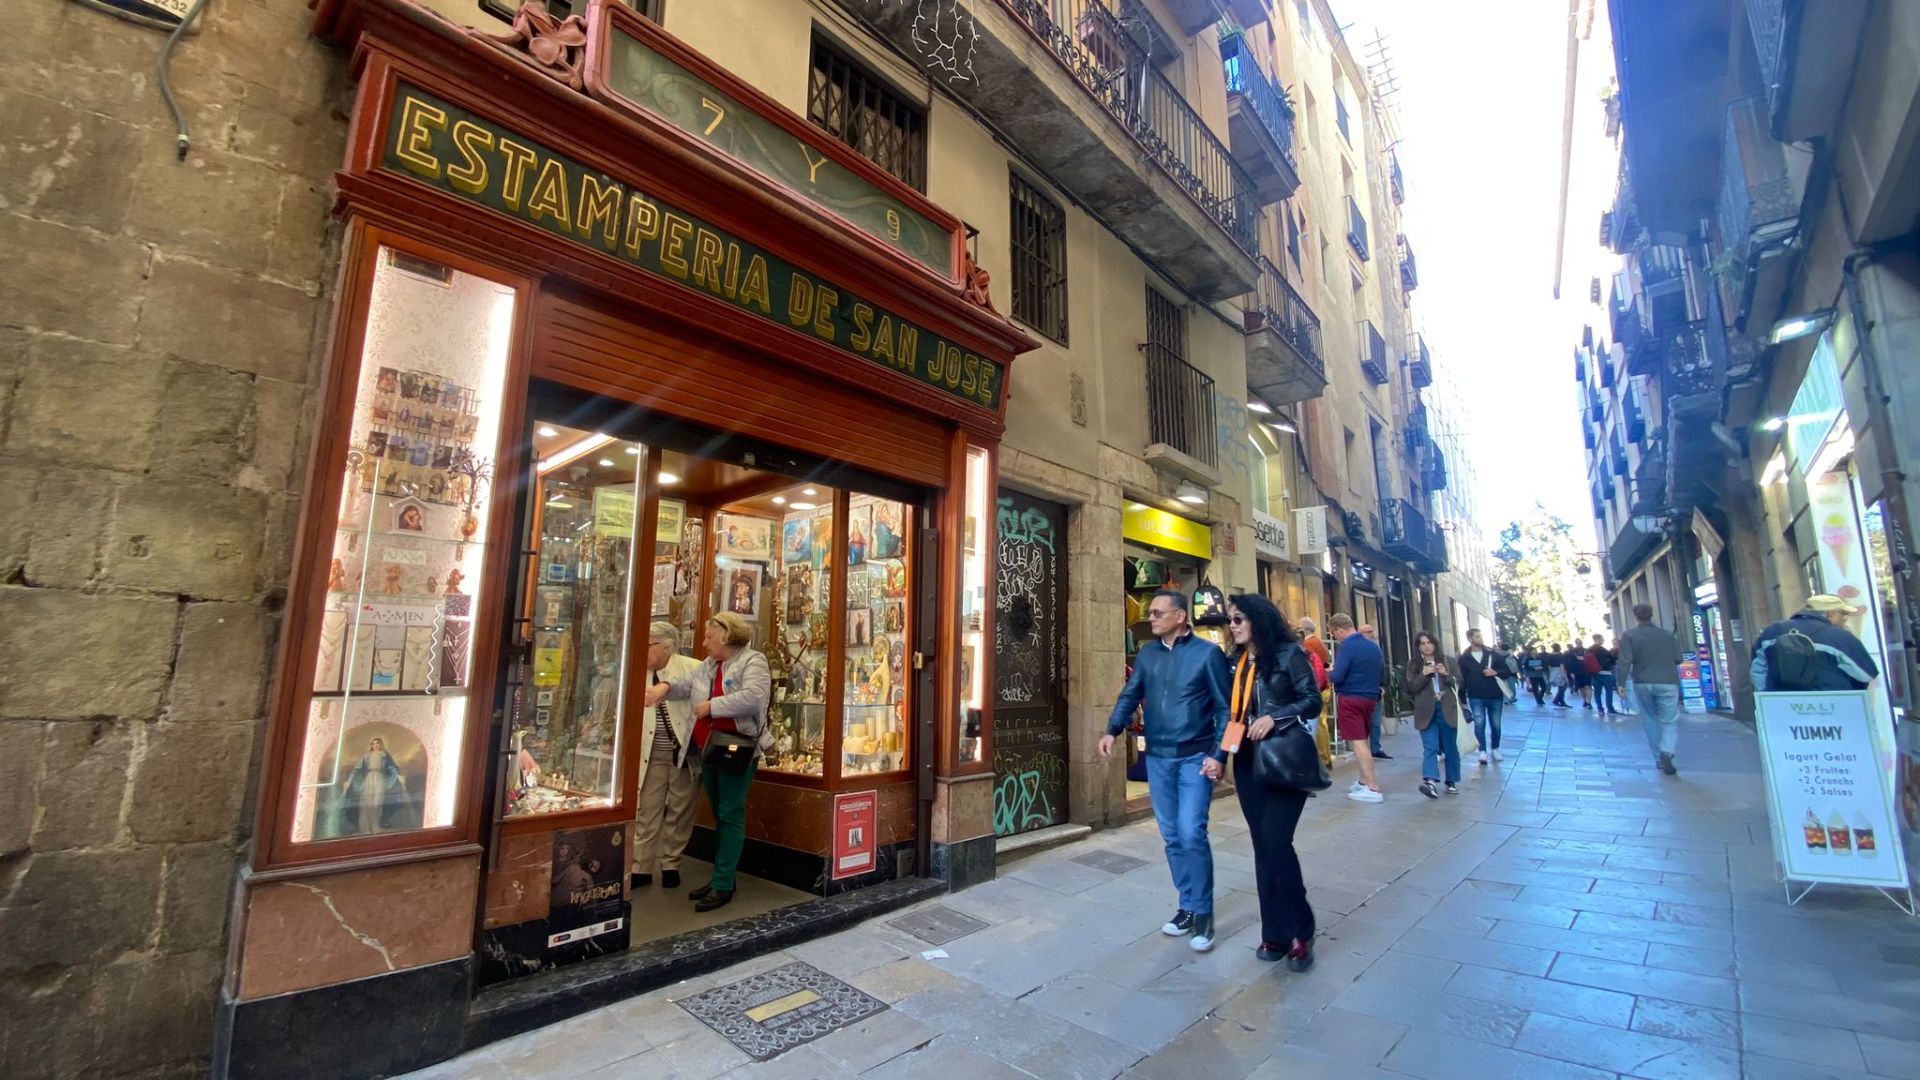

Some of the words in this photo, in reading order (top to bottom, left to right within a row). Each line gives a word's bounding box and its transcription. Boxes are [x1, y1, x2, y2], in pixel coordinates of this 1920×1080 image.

[702, 98, 725, 136] 7
[799, 143, 828, 184] Y
[886, 208, 900, 241] 9
[396, 96, 771, 314] ESTAMPERIA
[788, 272, 839, 340] DE
[851, 302, 919, 374] SAN
[928, 341, 995, 404] JOSE
[1790, 703, 1835, 712] WALI
[1789, 726, 1842, 740] YUMMY
[1823, 752, 1858, 762] Gelat
